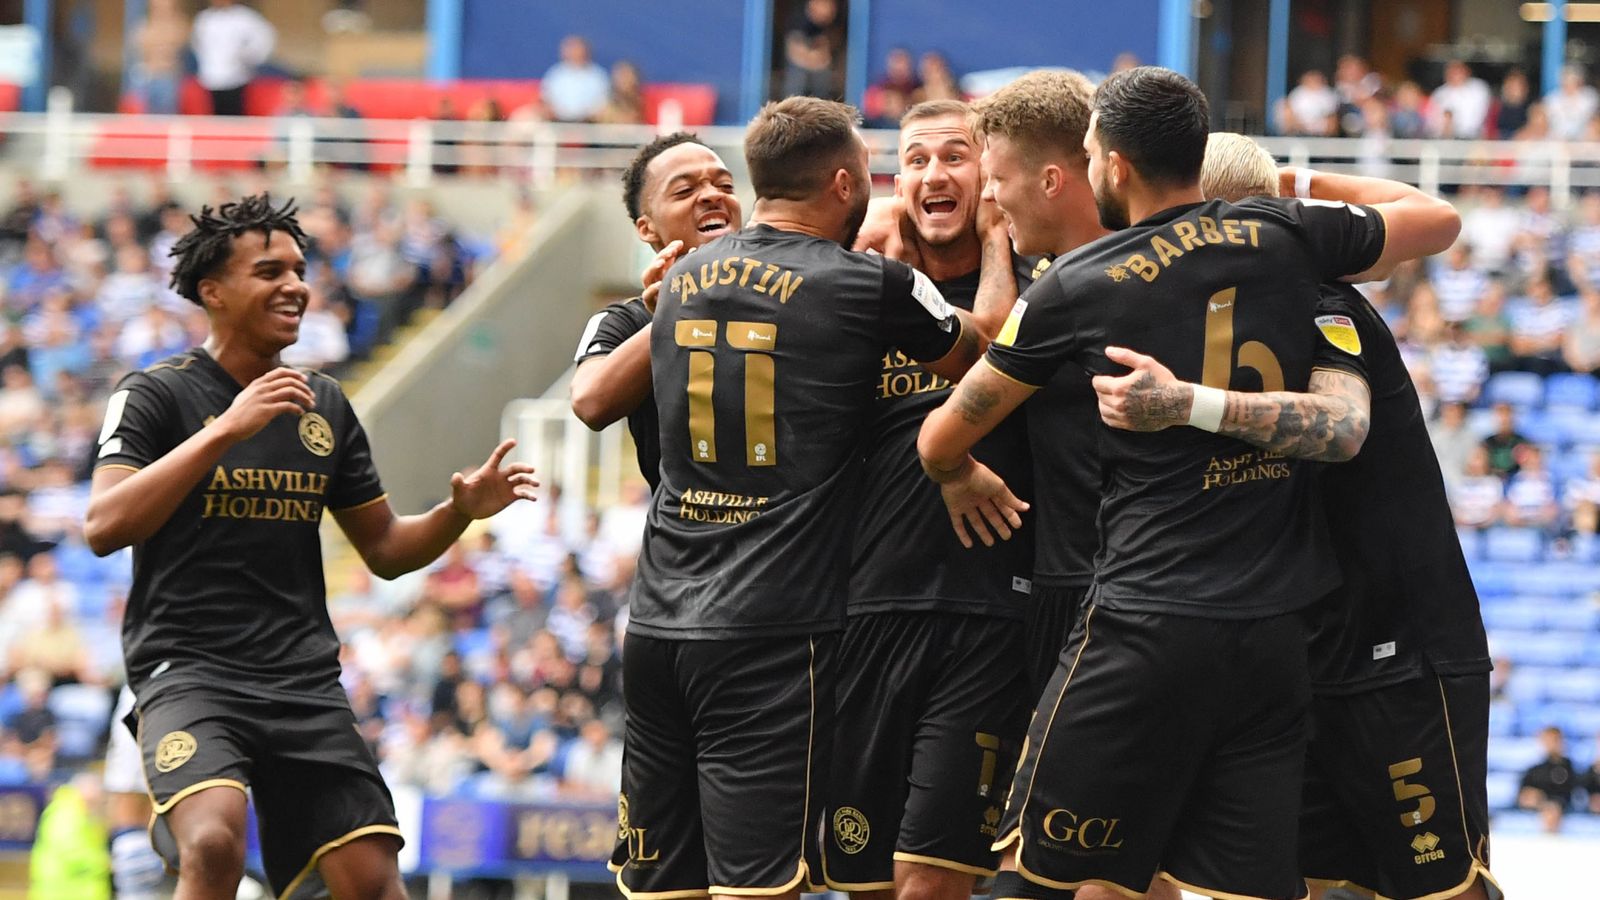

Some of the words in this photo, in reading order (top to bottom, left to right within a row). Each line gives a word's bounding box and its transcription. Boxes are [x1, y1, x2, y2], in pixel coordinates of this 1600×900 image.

[1124, 216, 1262, 283] BARBET
[680, 256, 804, 304] AUSTIN
[674, 319, 777, 467] 11
[208, 465, 329, 495] ASHVILLE
[202, 493, 319, 522] HOLDIN
[1388, 757, 1436, 828] 5
[1043, 808, 1124, 849] GCL
[1414, 849, 1446, 864] errea
